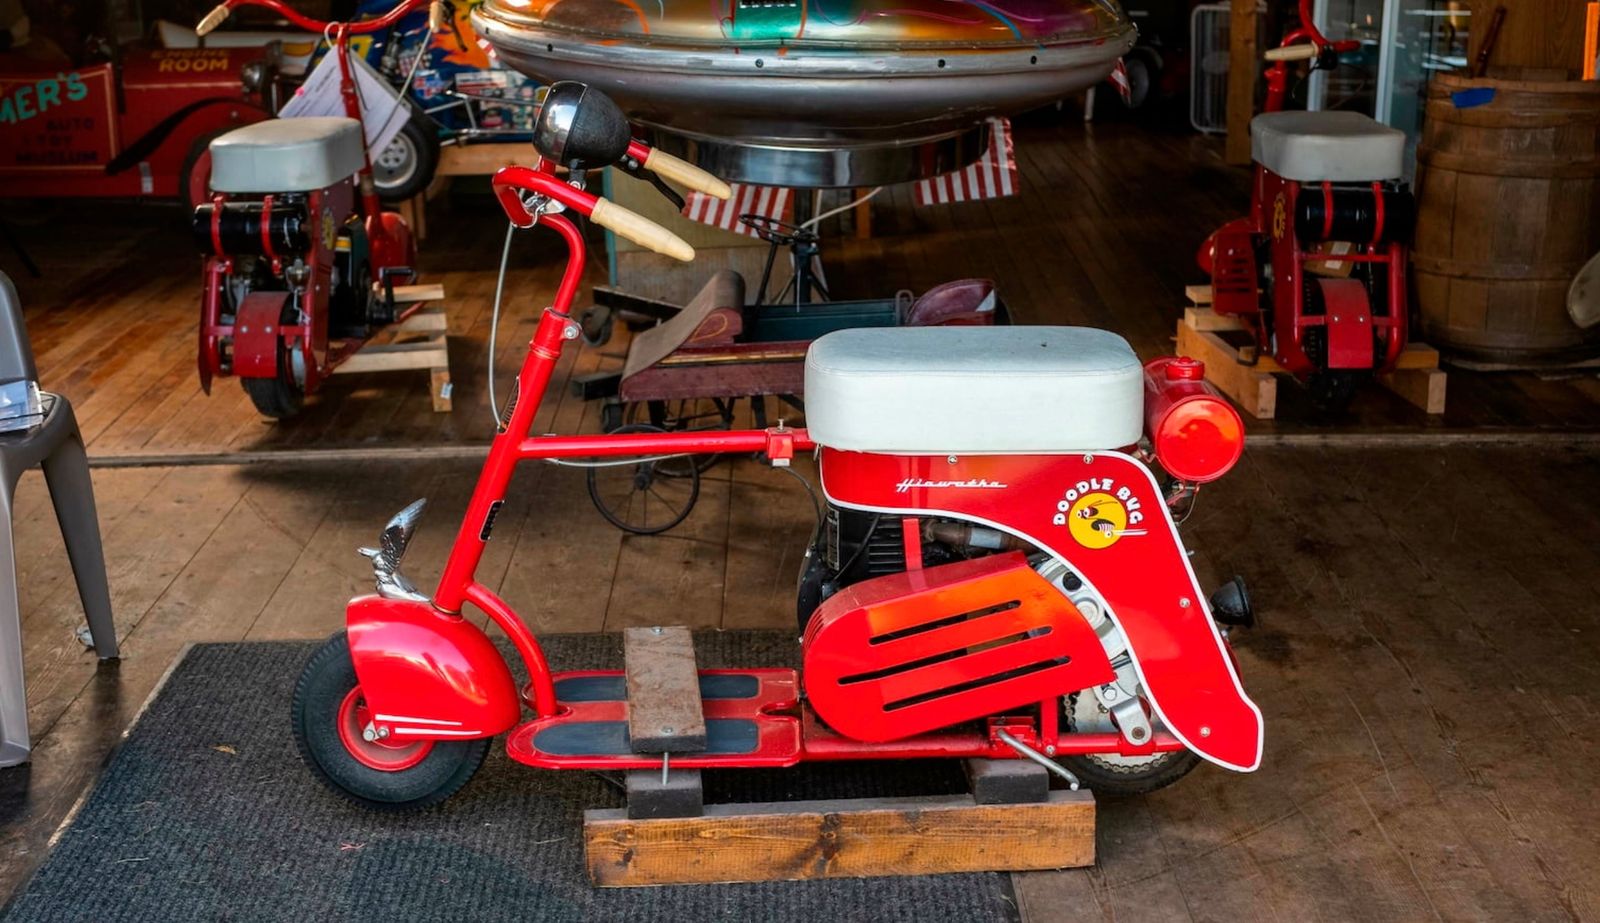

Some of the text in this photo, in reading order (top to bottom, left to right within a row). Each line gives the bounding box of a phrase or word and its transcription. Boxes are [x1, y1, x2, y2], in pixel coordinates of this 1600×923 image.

[158, 58, 228, 72] ROOM
[896, 479, 1007, 492] Hiawatha
[1053, 478, 1143, 525] DOODLE BUG
